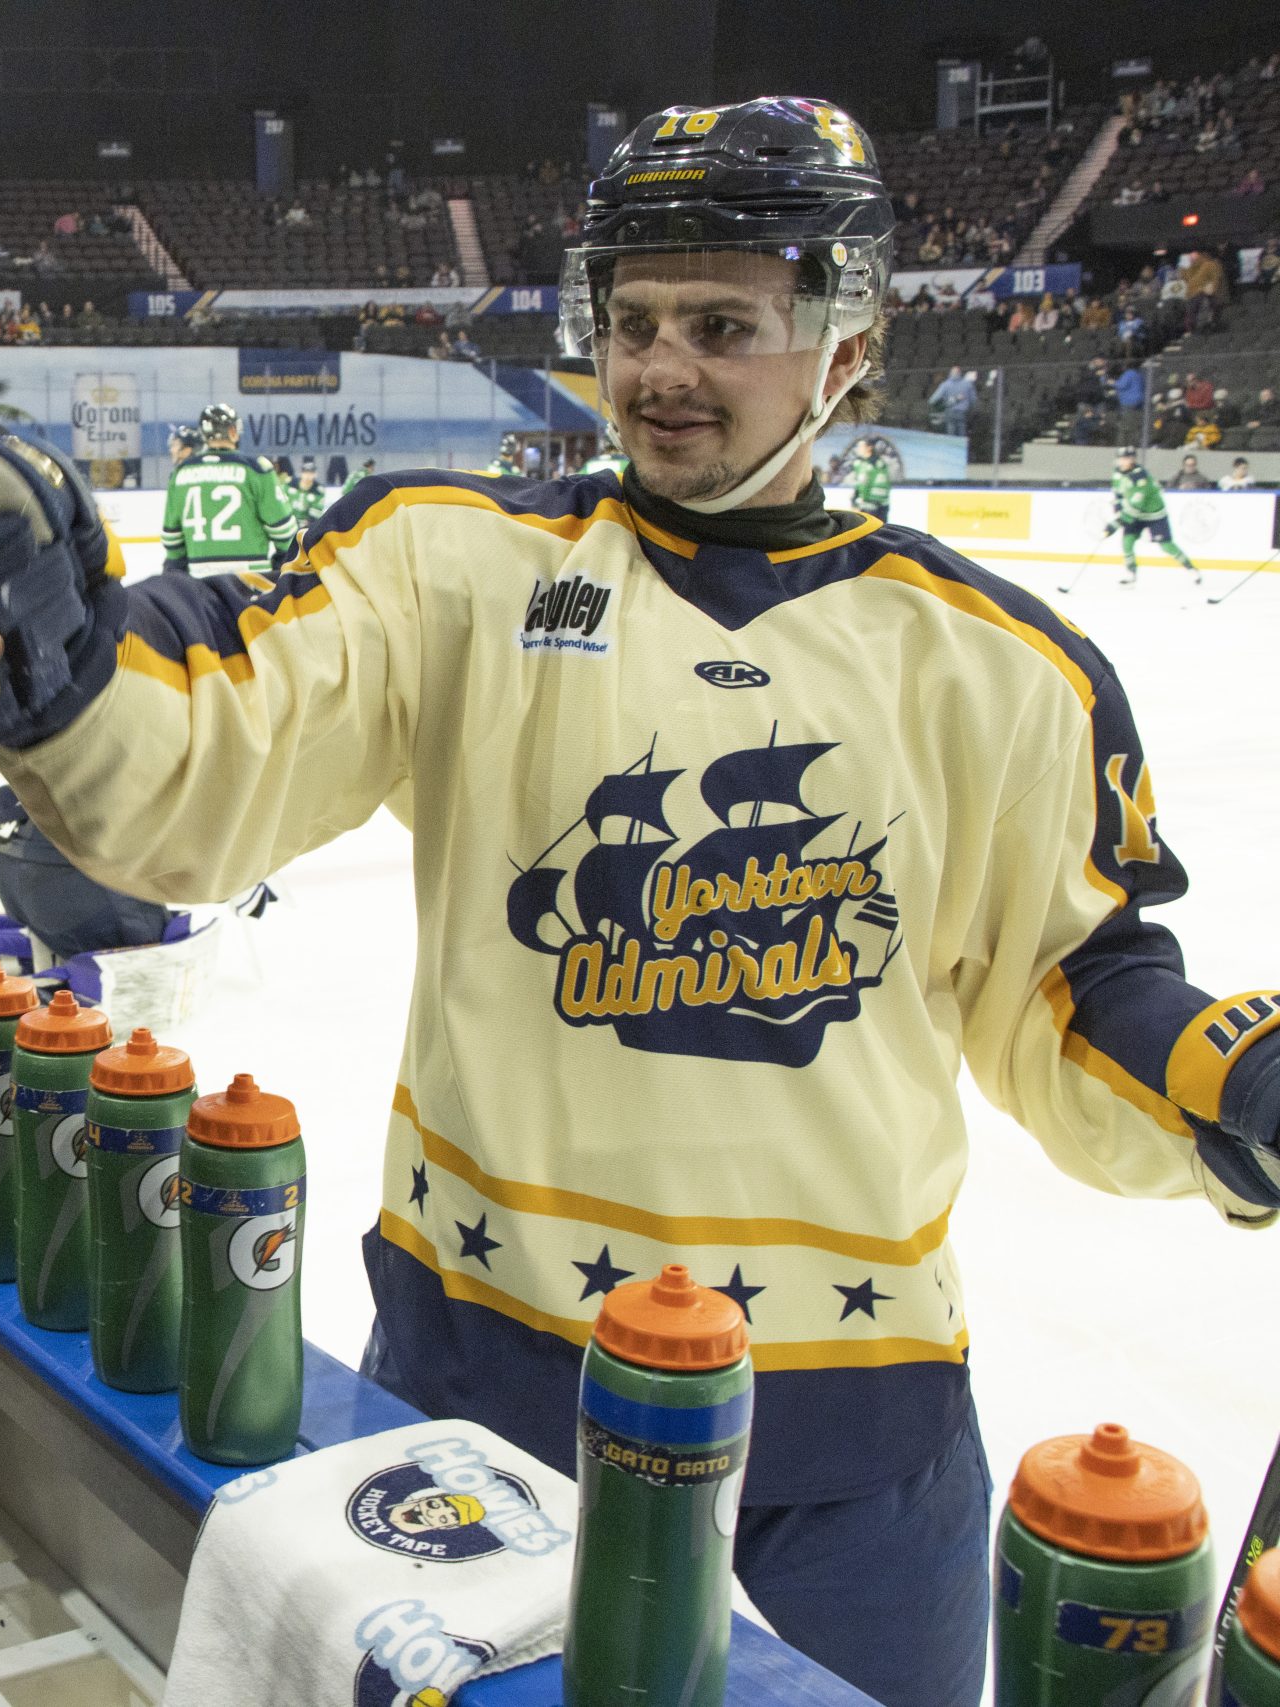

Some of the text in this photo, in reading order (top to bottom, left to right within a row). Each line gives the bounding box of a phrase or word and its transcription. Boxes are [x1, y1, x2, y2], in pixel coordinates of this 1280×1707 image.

[626, 169, 706, 185] WARRIOR
[1013, 269, 1045, 294] 103
[147, 294, 176, 316] 105
[511, 289, 542, 311] 104
[71, 400, 141, 430] Corona
[248, 404, 377, 447] VIDA MÁS
[87, 425, 128, 442] Extra
[183, 485, 242, 542] 42
[554, 638, 582, 650] Spend
[653, 852, 877, 941] Yorktown
[560, 913, 852, 1018] Admirals
[283, 1184, 299, 1209] 2
[228, 1213, 297, 1291] G
[606, 1443, 730, 1476] GATO GATO
[405, 1437, 573, 1558] HOWIES
[359, 1488, 447, 1556] HOCKEY TAPE
[354, 1599, 484, 1692] HOW
[1099, 1616, 1168, 1653] 73
